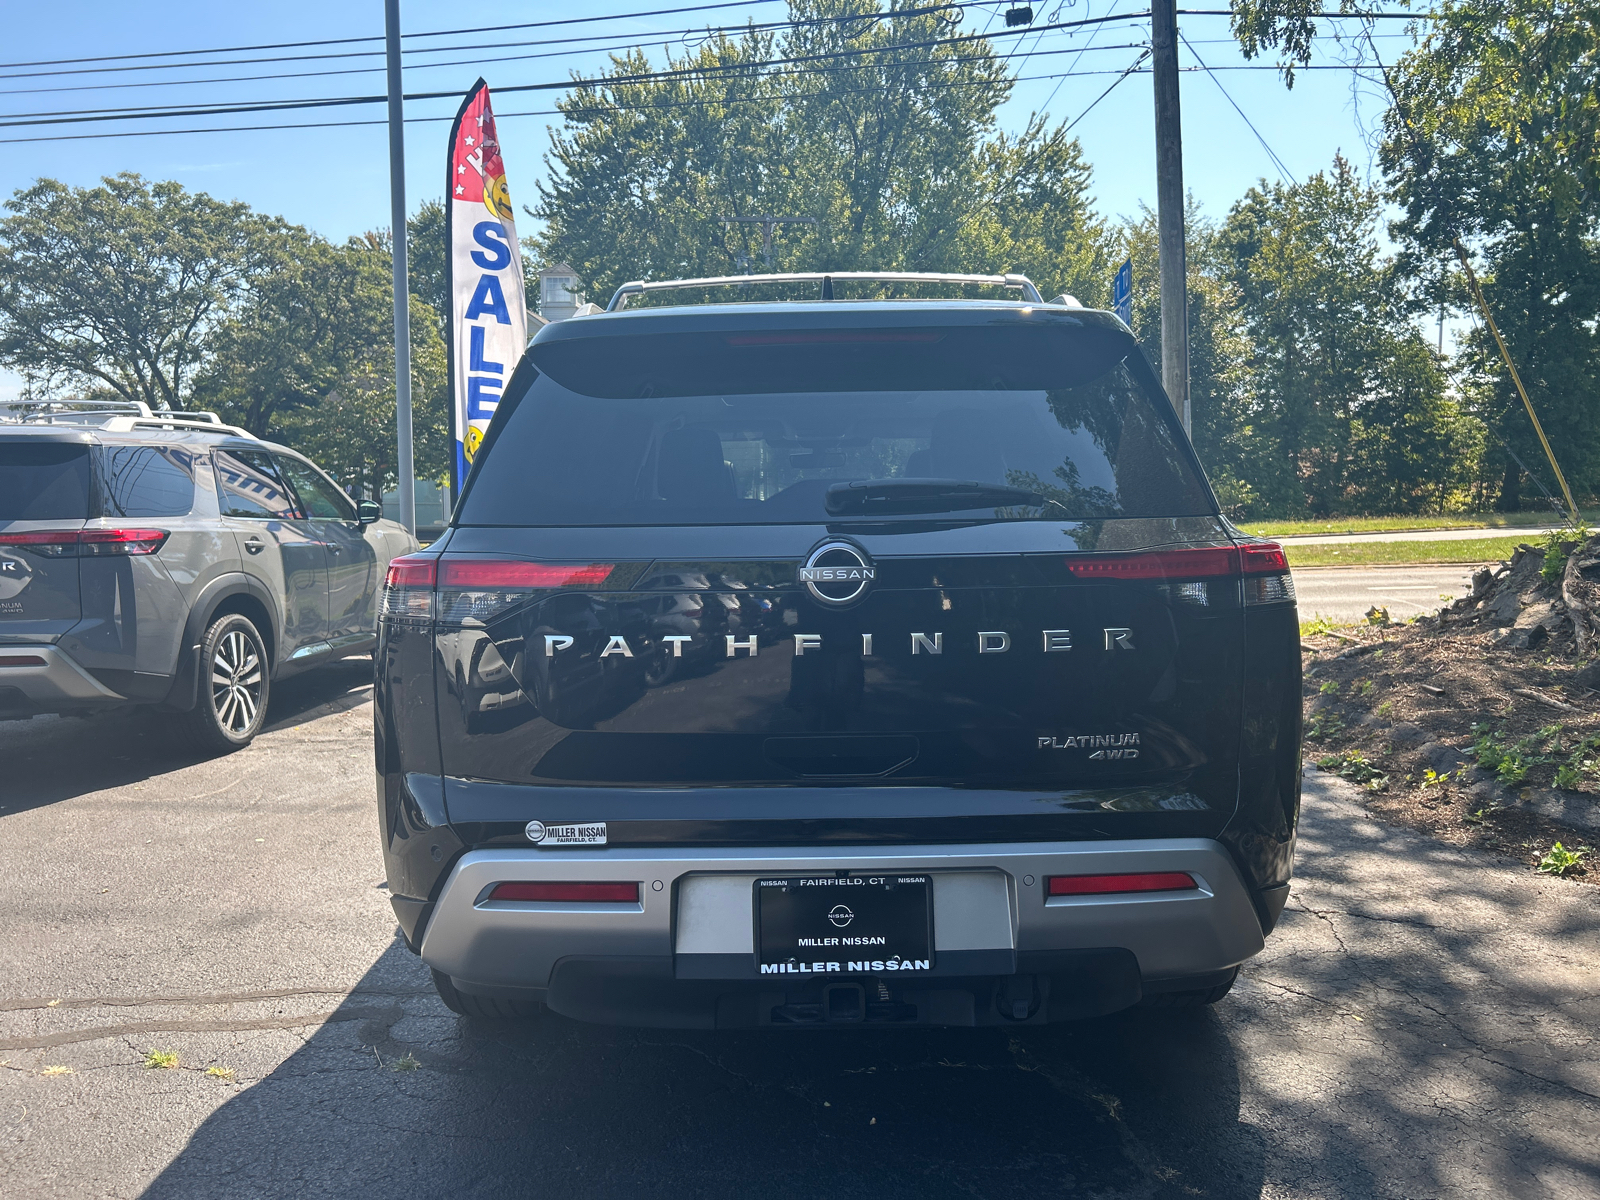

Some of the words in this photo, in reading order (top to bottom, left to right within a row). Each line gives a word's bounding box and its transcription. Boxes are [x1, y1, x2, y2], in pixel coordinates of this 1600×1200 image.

[464, 220, 512, 420] SALE
[802, 569, 875, 580] NISSAN
[543, 627, 1136, 658] PATHFINDER
[1038, 732, 1141, 749] PLATINUM
[1088, 748, 1140, 760] 4WD
[547, 827, 576, 838] MILLER
[578, 826, 606, 838] NISSAN
[800, 878, 866, 886] FAIRFIELD,
[869, 877, 886, 885] CT
[798, 938, 840, 947] MILLER
[842, 936, 886, 946] NISSAN
[760, 961, 841, 974] MILLER
[847, 960, 930, 972] NISSAN
